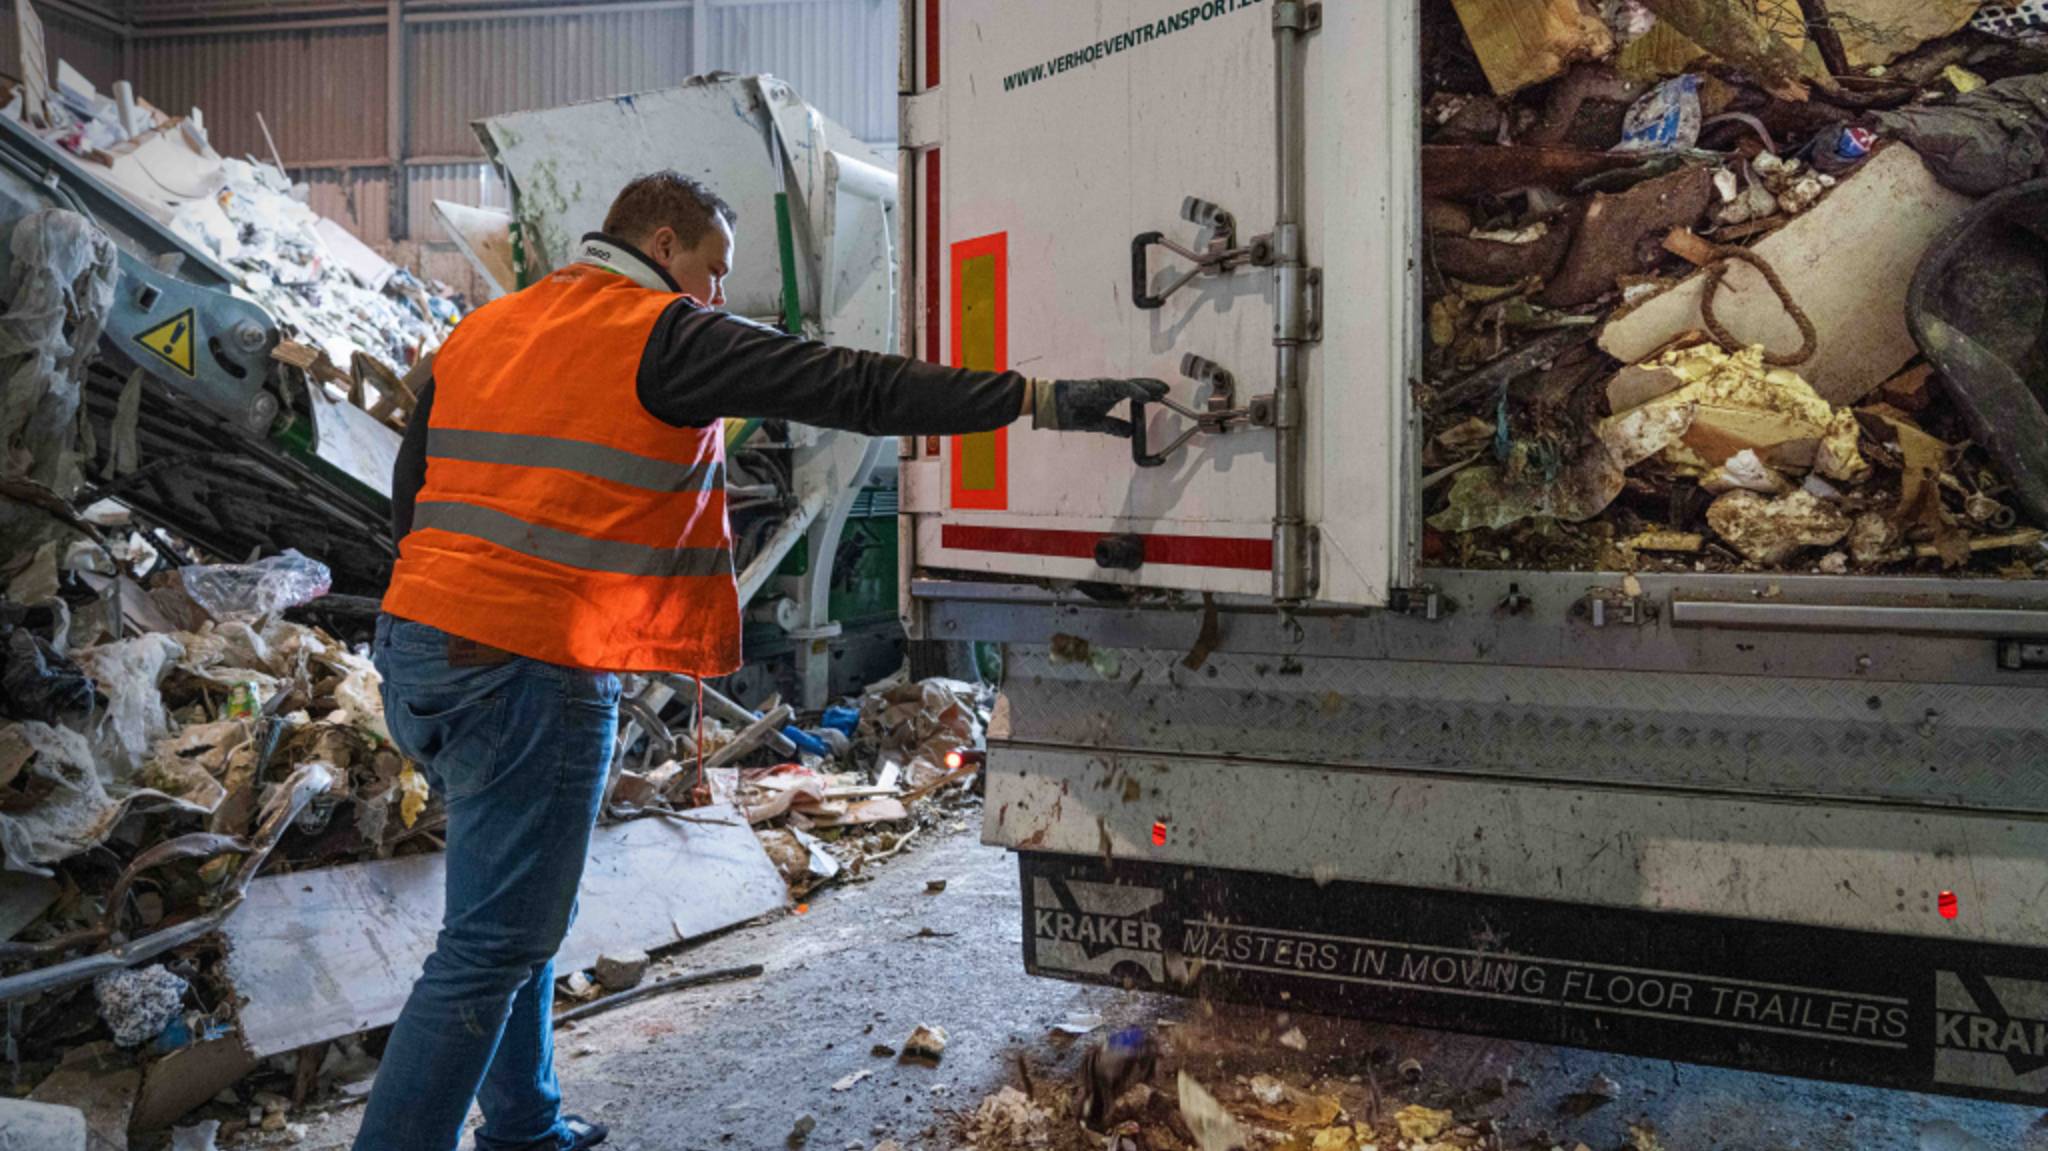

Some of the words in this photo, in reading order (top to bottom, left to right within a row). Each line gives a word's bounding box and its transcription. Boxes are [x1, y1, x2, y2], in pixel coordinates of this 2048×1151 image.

[1003, 0, 1263, 92] WWW.VERHOEVENTRANSPORT.
[1035, 909, 1162, 950] KRAKER
[1183, 928, 1339, 971] MASTERS
[1352, 949, 1387, 976] IN
[1400, 953, 1547, 994] MOVING
[1562, 969, 1694, 1011] FLOOR
[1711, 987, 1909, 1038] TRAILERS
